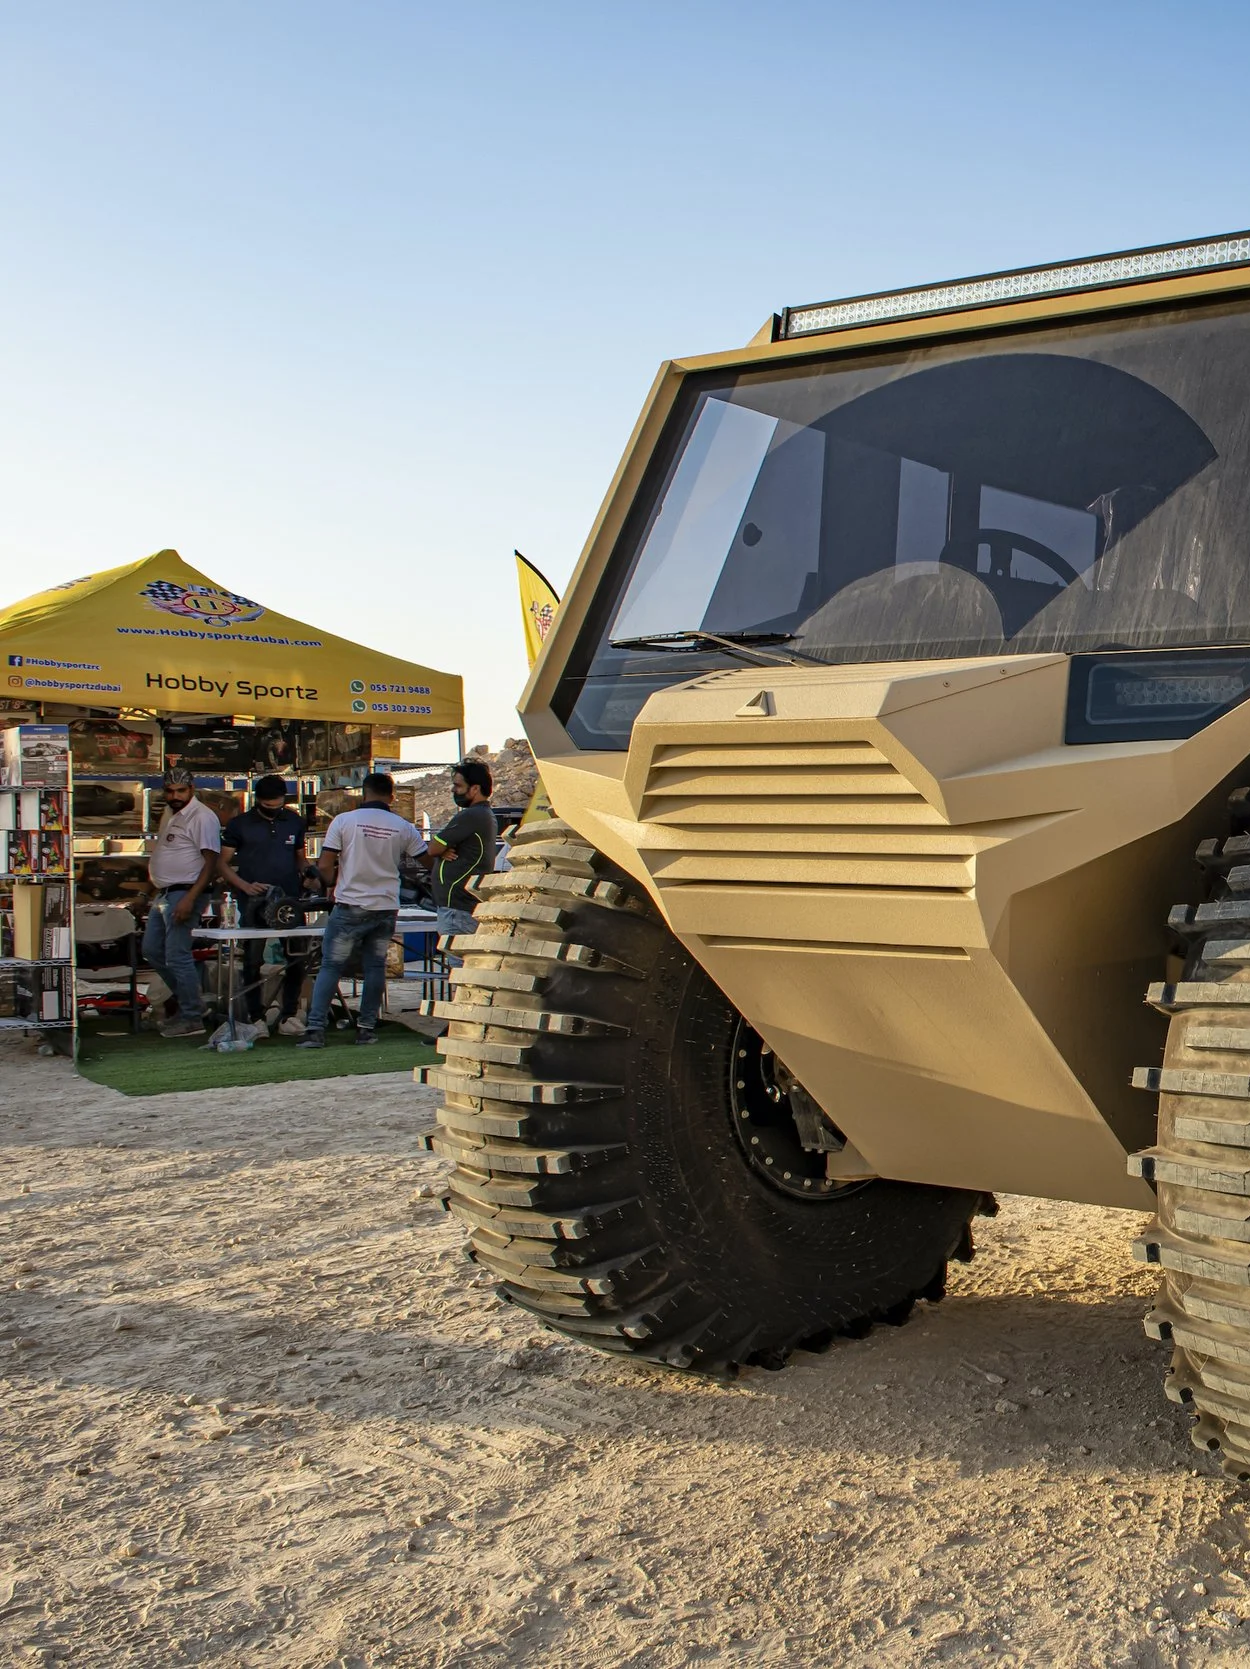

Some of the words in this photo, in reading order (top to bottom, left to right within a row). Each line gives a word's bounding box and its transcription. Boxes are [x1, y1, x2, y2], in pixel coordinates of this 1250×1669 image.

[117, 626, 322, 647] www.Hobbysportzdubai.com
[25, 657, 101, 671] #Hobbysportzrc
[25, 678, 121, 692] @hobbysportzdubai
[146, 672, 229, 698] Hobby
[236, 680, 318, 701] Sportz
[370, 684, 387, 692] 055
[389, 684, 406, 694] 721
[408, 686, 431, 695] 9488
[371, 703, 389, 712] 055
[391, 704, 408, 713] 302
[409, 705, 432, 715] 9295
